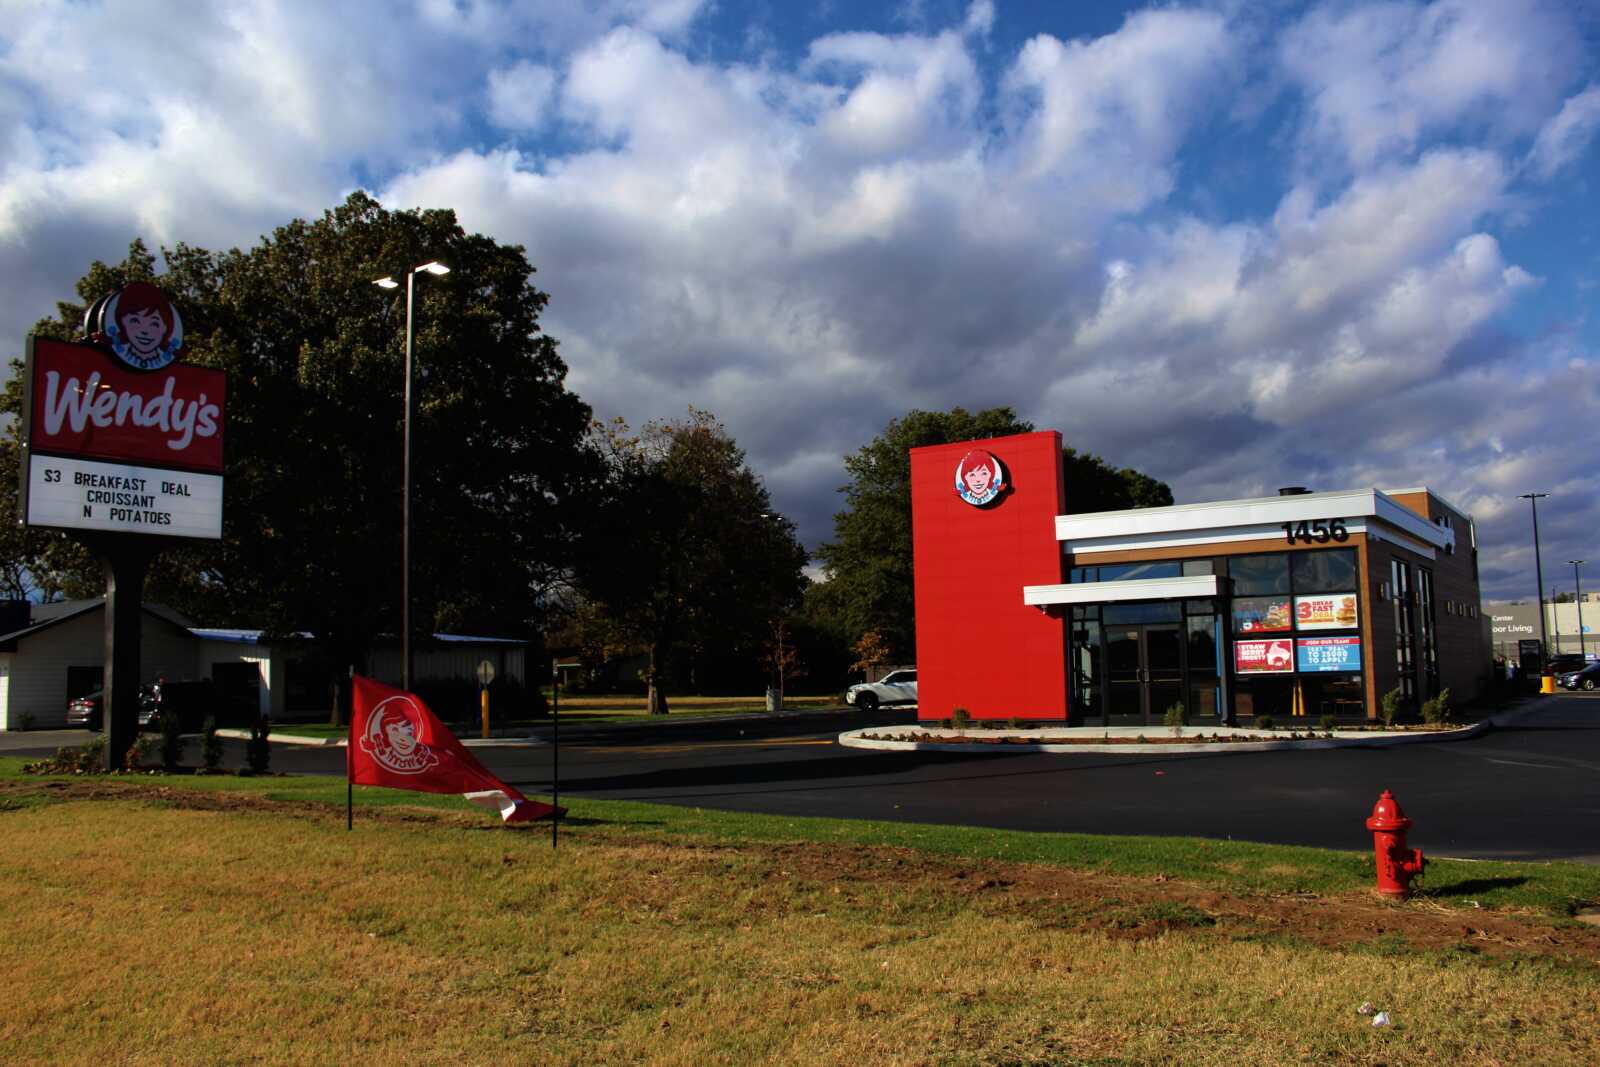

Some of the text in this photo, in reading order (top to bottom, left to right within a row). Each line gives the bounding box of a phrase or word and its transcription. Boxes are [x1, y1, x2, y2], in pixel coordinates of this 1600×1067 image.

[44, 370, 220, 450] Wendy's
[74, 472, 147, 492] BREAKFAST
[161, 481, 191, 497] DEAL
[87, 490, 155, 508] CROISSANT
[83, 505, 172, 525] N POTATOES
[1281, 518, 1349, 545] 1456
[1297, 601, 1312, 619] 3
[1507, 624, 1533, 633] Living
